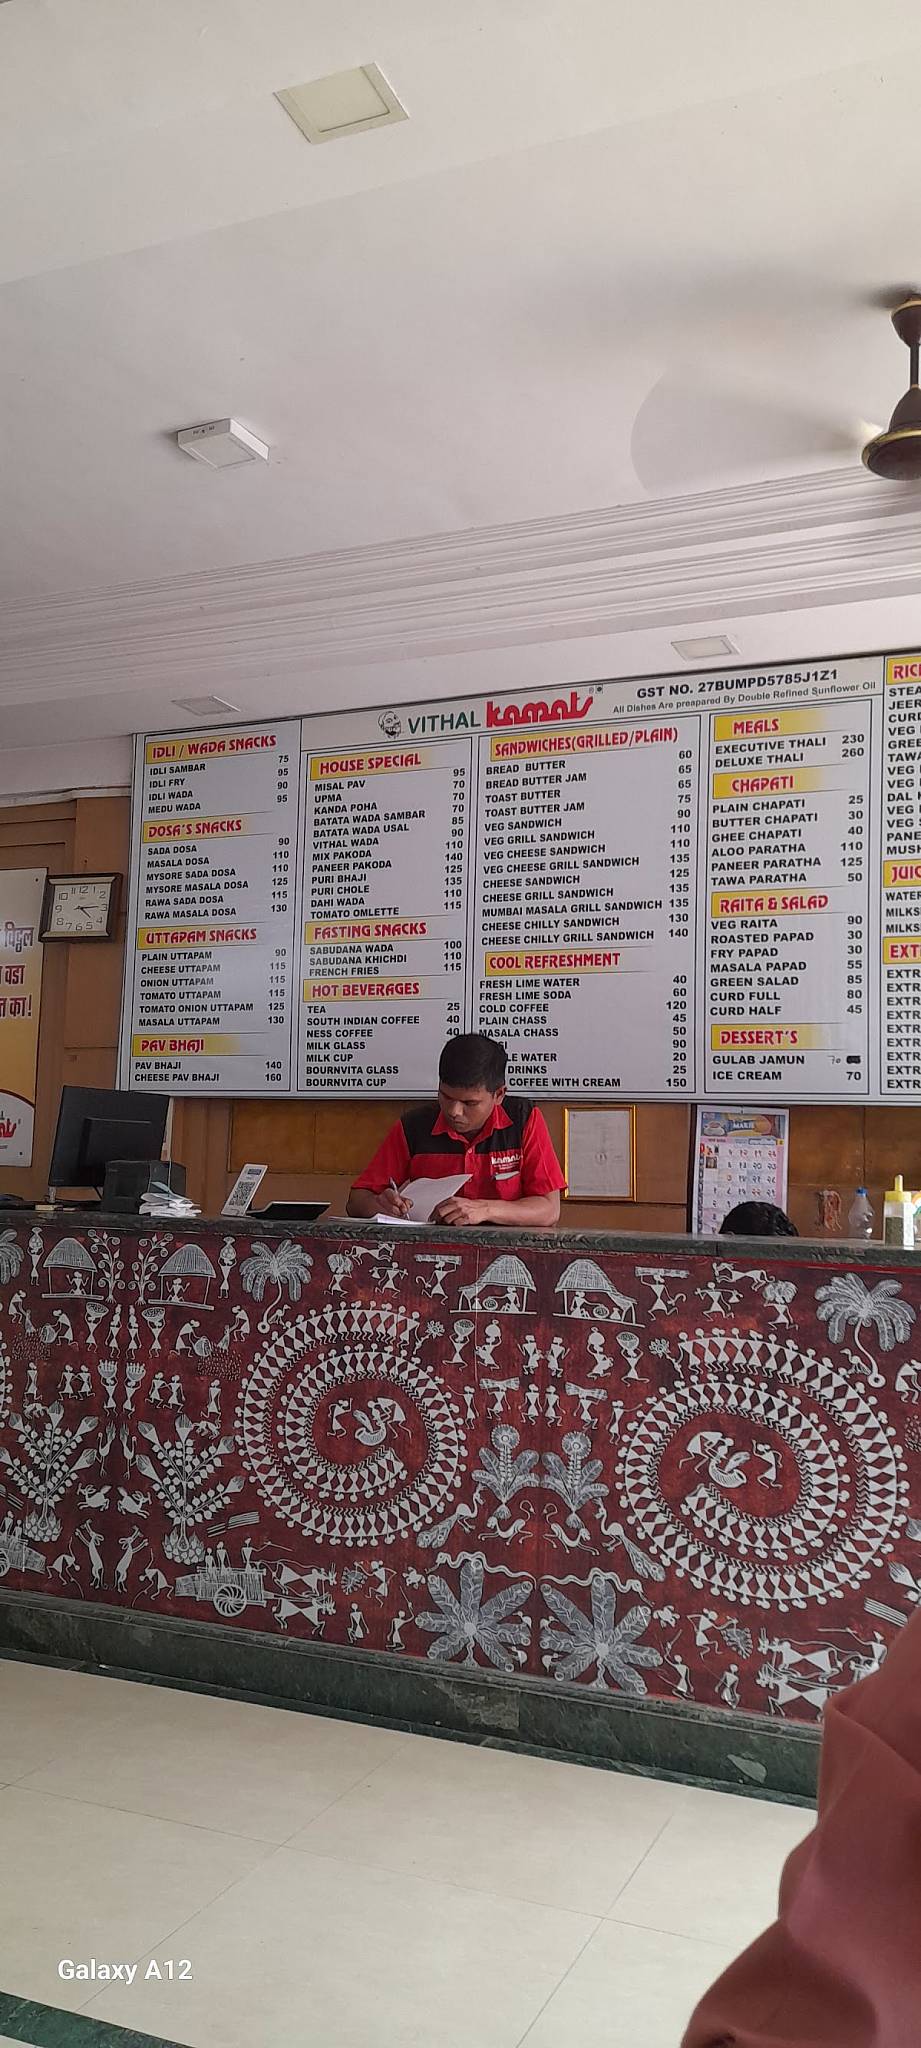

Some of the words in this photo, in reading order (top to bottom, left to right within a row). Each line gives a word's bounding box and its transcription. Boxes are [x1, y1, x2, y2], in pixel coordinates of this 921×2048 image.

[637, 687, 665, 698] GST
[669, 684, 693, 695] NO.
[698, 670, 837, 692] 27BUMPD5785J1Z1
[613, 705, 624, 713] All
[627, 703, 656, 712] Dishes
[658, 701, 674, 709] Are
[676, 696, 721, 708] preapared
[723, 696, 736, 704] By
[738, 692, 770, 702] Double
[773, 688, 809, 699] Refined
[811, 683, 859, 696] Sunflower
[862, 682, 875, 690] Oil
[408, 711, 481, 734] VITHAL
[486, 692, 593, 728] kamats
[734, 719, 779, 734] MEALS
[888, 726, 915, 736] VEG
[153, 747, 175, 759] IDLI
[179, 745, 184, 757] /
[188, 741, 225, 755] WADA
[229, 736, 276, 750] SNACKS
[715, 742, 785, 754] EXECUTIVE
[789, 738, 826, 748] THALI
[842, 734, 864, 744] 230
[170, 763, 206, 774] SAMBAR
[320, 759, 364, 774] HOUSE
[368, 753, 421, 769] SPECIAL
[486, 780, 519, 789] BREAD
[522, 776, 562, 786] BUTTER
[566, 773, 587, 783] JAM
[679, 765, 692, 774] 65
[732, 776, 794, 792] CHAPATI
[315, 794, 342, 803] UPMA
[888, 792, 912, 801] DAL
[149, 806, 173, 814] MEDU
[176, 803, 201, 811] WADA
[277, 795, 288, 803] 95
[314, 817, 349, 826] BATATA
[352, 814, 380, 823] WADA
[384, 811, 425, 820] SAMBAR
[712, 817, 760, 827] BUTTER
[765, 814, 818, 824] CHAPATI
[848, 811, 863, 820] 30
[149, 824, 192, 837] DOSA'S
[196, 820, 242, 834] SNACKS
[484, 837, 504, 846] VEG
[507, 835, 536, 844] GRILL
[540, 831, 595, 842] SANDWICH
[671, 824, 690, 833] 110
[147, 860, 183, 868] MASALA
[186, 857, 209, 866] DOSA
[712, 861, 759, 871] PANEER
[764, 858, 821, 868] PARATHA
[841, 857, 862, 866] 125
[146, 885, 182, 893] MYSORE
[185, 883, 221, 892] MASALA
[224, 881, 248, 889] DOSA
[311, 910, 350, 919] TOMATO
[353, 907, 399, 917] OMLETTE
[444, 901, 461, 909] 115
[720, 899, 764, 913] RAITA
[768, 898, 777, 910] &
[782, 895, 828, 910] SALAD
[146, 931, 206, 944] UTTAPAM
[209, 928, 257, 942] SNACKS
[314, 926, 371, 939] FASTING
[374, 923, 427, 936] SNACKS
[482, 936, 521, 946] CHEESE
[524, 934, 560, 944] CHILLY
[563, 933, 593, 943] GRILL
[596, 931, 654, 941] SANDWICH
[668, 929, 688, 937] 140
[711, 935, 769, 944] ROASTED
[773, 932, 814, 942] PAPAD
[848, 931, 862, 939] 30
[142, 953, 168, 961] PLAIN
[170, 952, 212, 960] UTTAPAM
[890, 944, 921, 958] EXT
[490, 957, 521, 969] COOL
[525, 953, 620, 969] REFRESHMENT
[310, 968, 348, 976] FRENCH
[351, 967, 379, 975] FRIES
[444, 963, 461, 971] 115
[312, 985, 338, 997] HOT
[343, 983, 420, 996] BEVERAGES
[479, 992, 512, 1001] FRESH
[516, 992, 540, 1000] LIME
[543, 991, 571, 999] SODA
[673, 988, 687, 997] 60
[140, 1005, 175, 1013] TOMATO
[178, 1004, 207, 1012] ONION
[210, 1003, 253, 1012] UTTAPAM
[307, 1018, 340, 1026] SOUTH
[344, 1017, 378, 1025] INDIAN
[381, 1016, 420, 1024] COFFEE
[721, 1030, 798, 1044] DESSERT'S
[141, 1040, 165, 1051] PAV
[169, 1039, 204, 1051] BHAJI
[712, 1056, 755, 1064] GULAB
[759, 1055, 805, 1064] JAMUN
[192, 1073, 219, 1081] BHAJI
[366, 1078, 386, 1086] CUP
[509, 1078, 548, 1087] COFFEE
[552, 1078, 579, 1087] WITH
[583, 1079, 620, 1087] CREAM
[666, 1078, 686, 1087] 150
[713, 1072, 733, 1080] ICE
[738, 1072, 782, 1080] CREAM
[846, 1072, 861, 1080] 70
